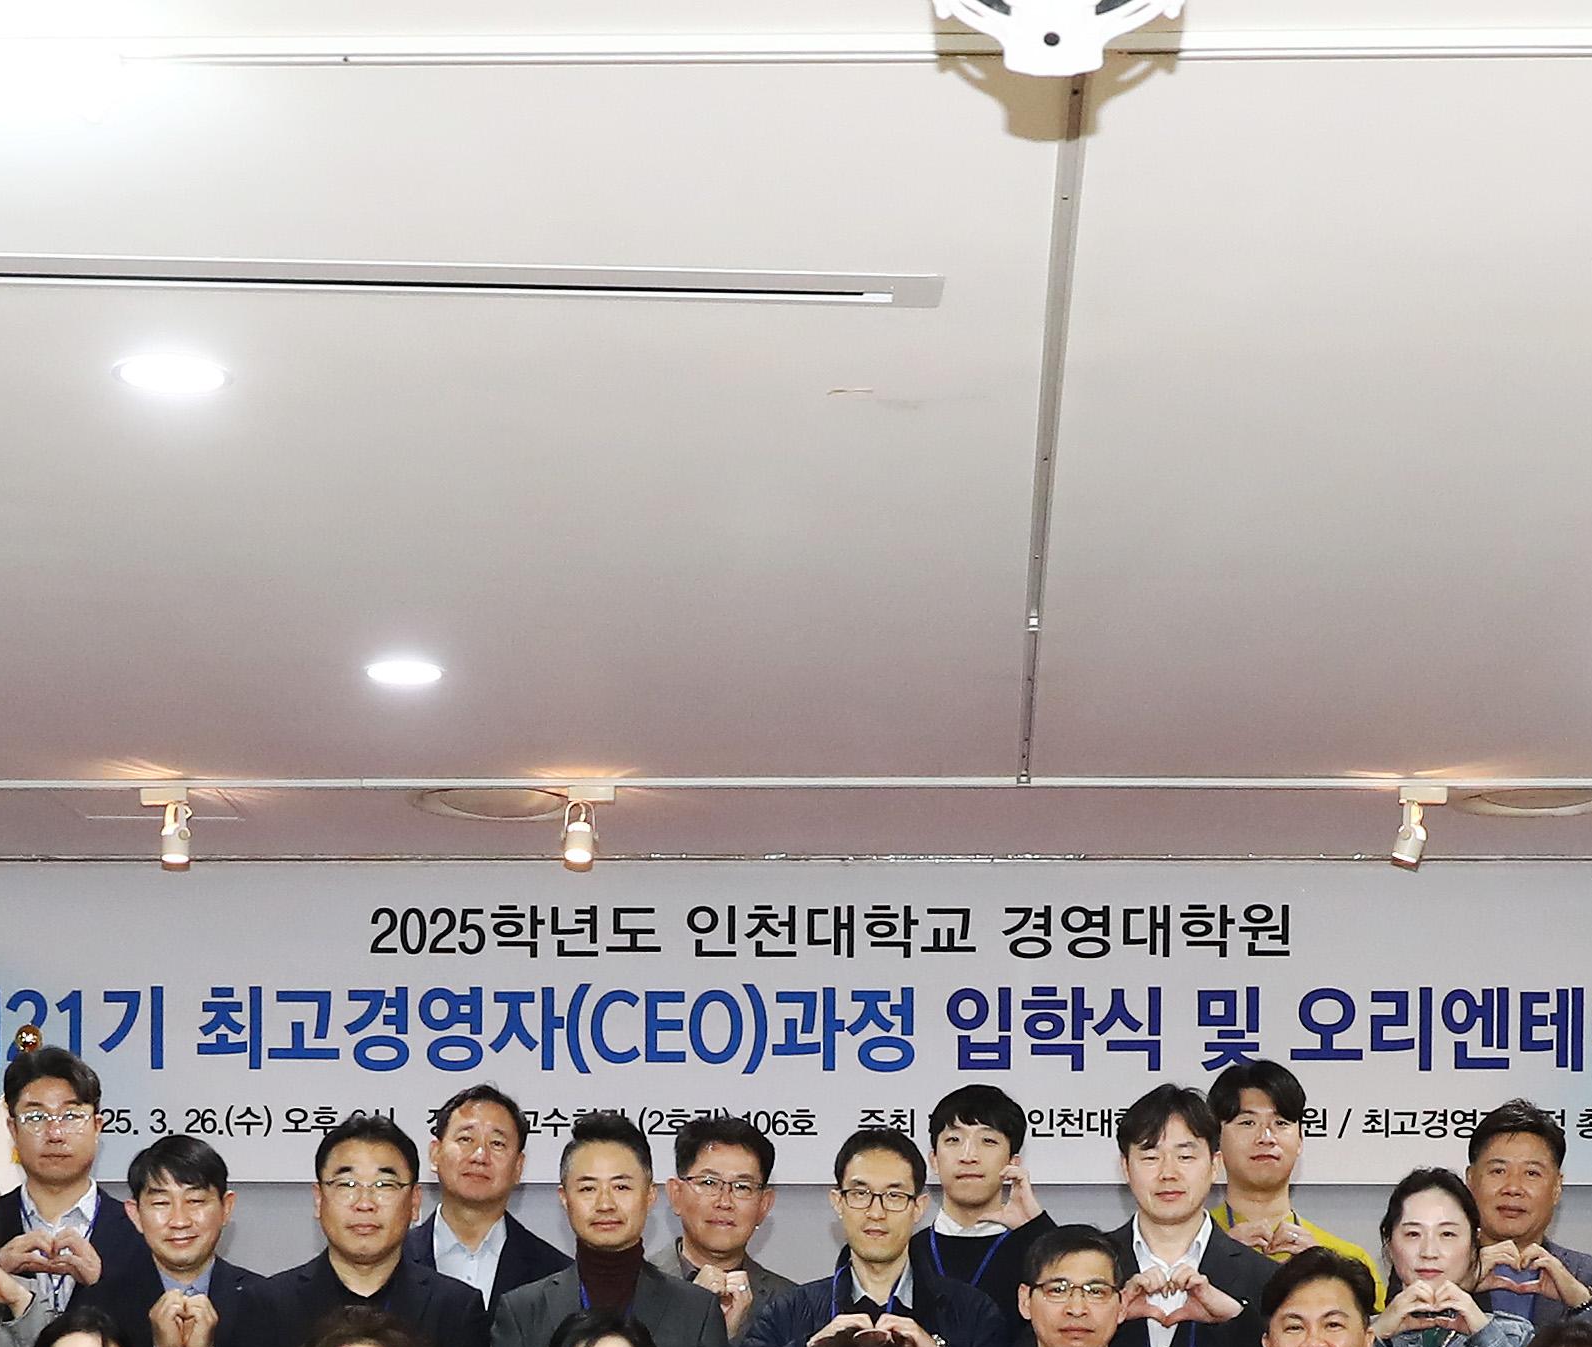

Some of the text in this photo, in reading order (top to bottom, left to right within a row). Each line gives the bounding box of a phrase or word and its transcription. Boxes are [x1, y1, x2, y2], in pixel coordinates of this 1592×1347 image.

[370, 904, 1290, 959] 2025학년도 인천대학교 경영대학원
[197, 984, 914, 1074] 최고경영자(CEO)과정
[947, 986, 1161, 1072] 입학식
[1197, 986, 1261, 1072] 및
[100, 1109, 138, 1134] 25.
[185, 1105, 272, 1136] 26.(수)
[520, 1108, 629, 1137] 교수
[1027, 1108, 1129, 1138] 인천대
[1362, 1108, 1565, 1138] 최고경영
